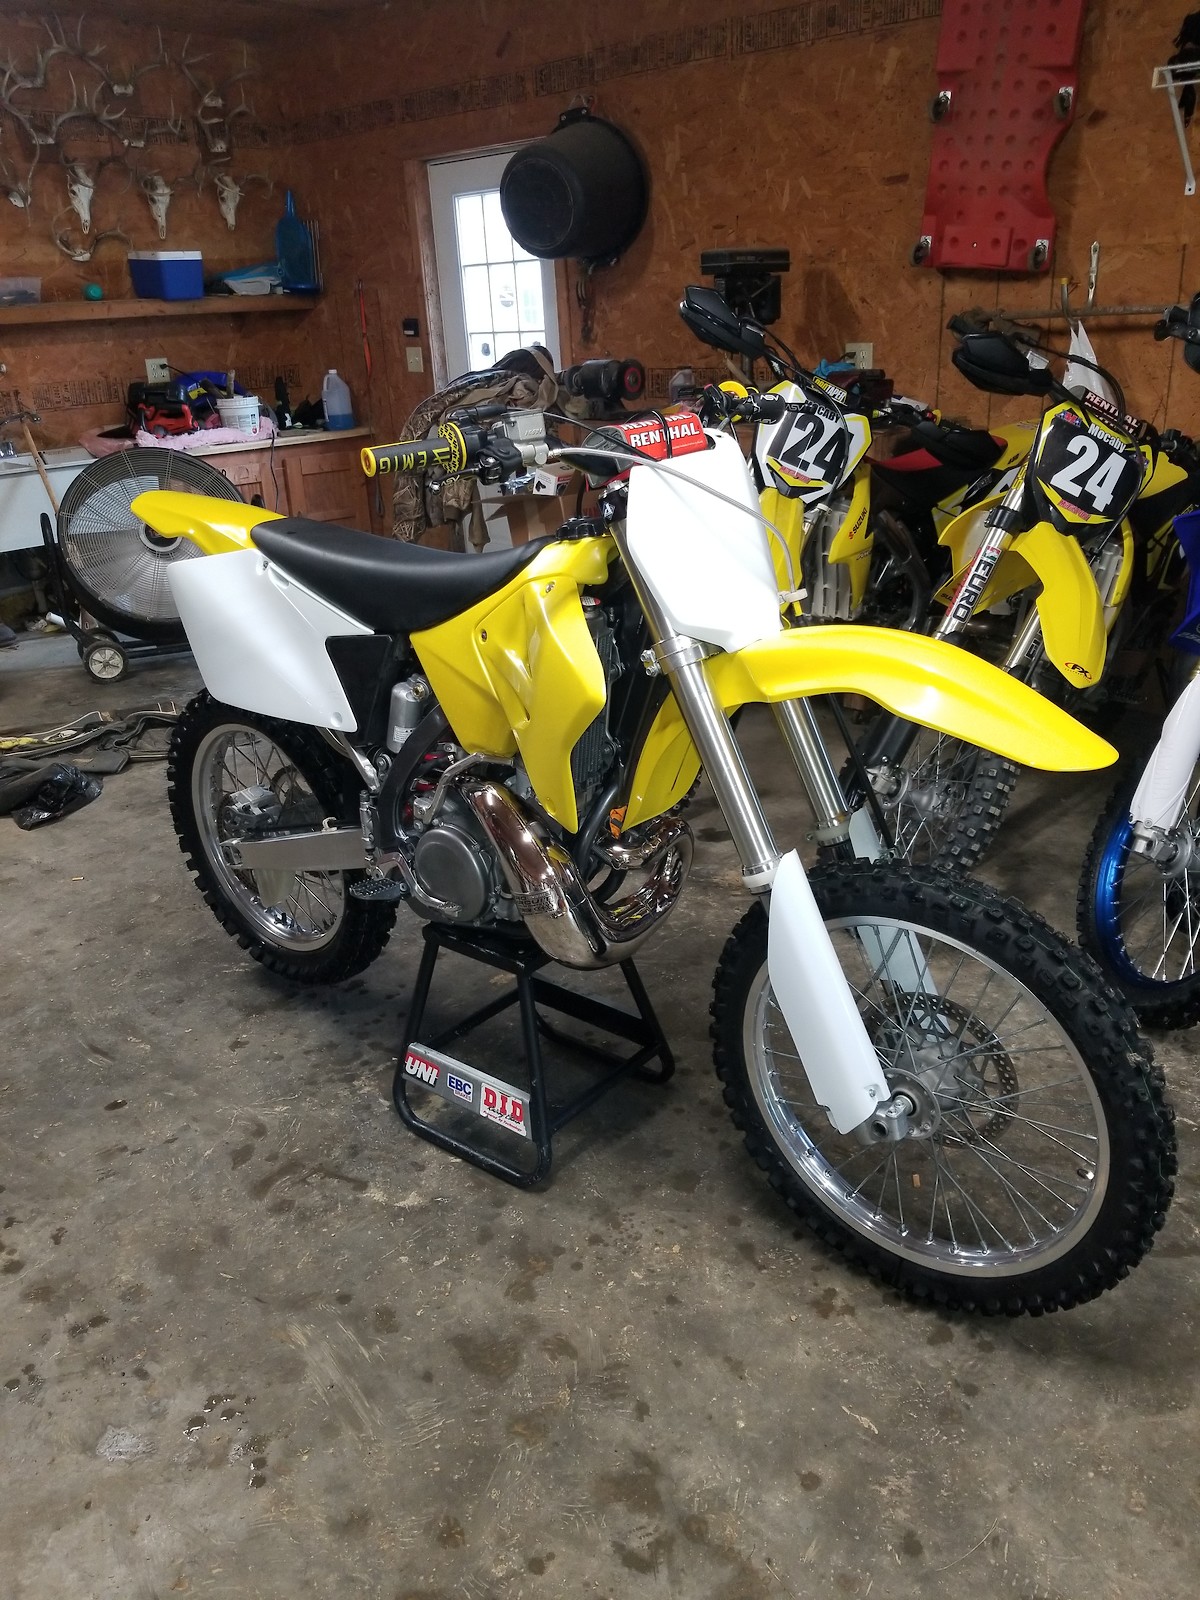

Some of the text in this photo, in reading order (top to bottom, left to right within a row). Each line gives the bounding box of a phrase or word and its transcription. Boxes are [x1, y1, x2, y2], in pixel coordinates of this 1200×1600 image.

[1085, 391, 1138, 428] RENTAL
[630, 422, 700, 448] RENTHAL
[1050, 434, 1127, 513] 24
[405, 1055, 439, 1086] UNI
[448, 1074, 473, 1095] EBC
